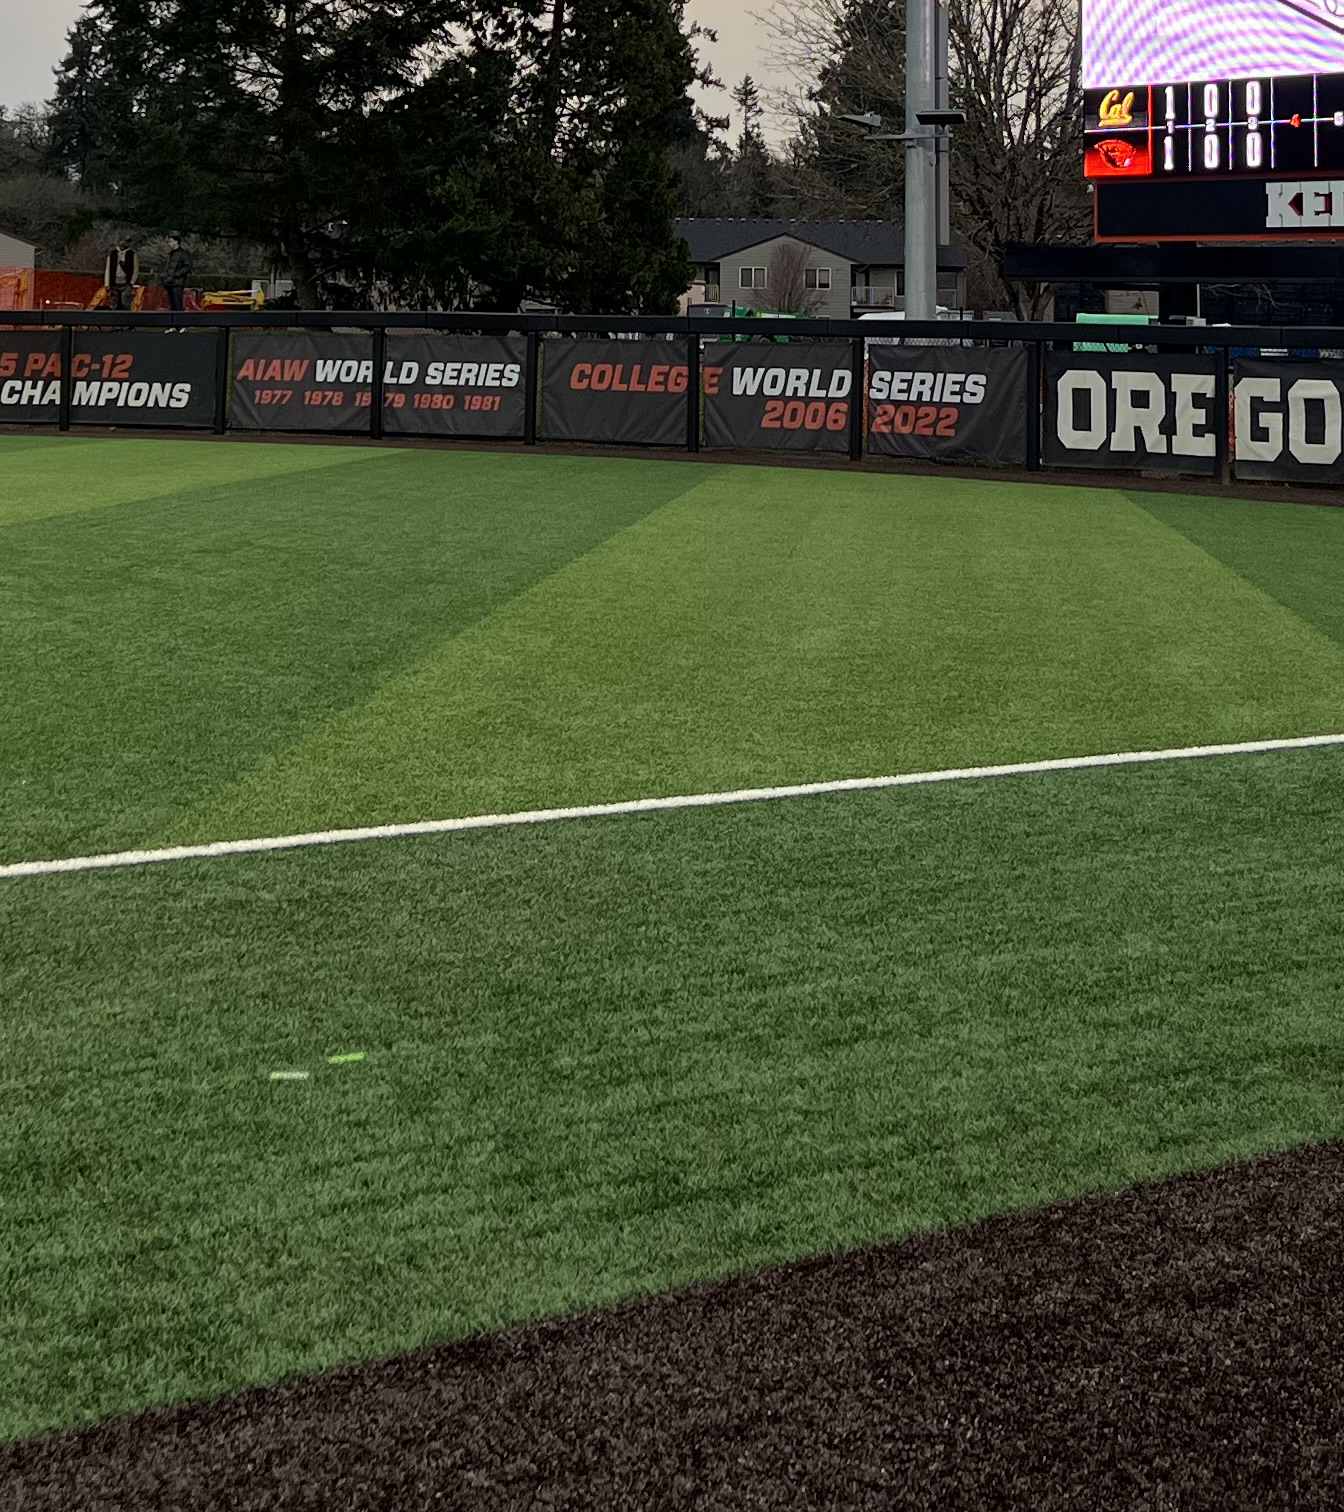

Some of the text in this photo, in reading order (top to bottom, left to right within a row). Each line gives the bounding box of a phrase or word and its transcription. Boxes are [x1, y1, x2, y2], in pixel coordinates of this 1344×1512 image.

[1098, 89, 1136, 127] Cal
[1164, 86, 1176, 119] 1
[1204, 83, 1219, 118] 0
[1246, 81, 1262, 115] 0
[1290, 113, 1301, 128] 4
[1163, 136, 1174, 170] 1
[1204, 134, 1219, 169] 0
[1246, 132, 1262, 168] 0
[24, 353, 134, 379] PAC-12
[236, 358, 521, 387] AIAW WORLD SERIES
[0, 380, 192, 408] CHAMPIONS
[570, 363, 987, 404] COLLEGE WORLD SERIES
[254, 389, 502, 411] 1977 1978 1979 1980 1981
[761, 400, 959, 437] 2006 2022
